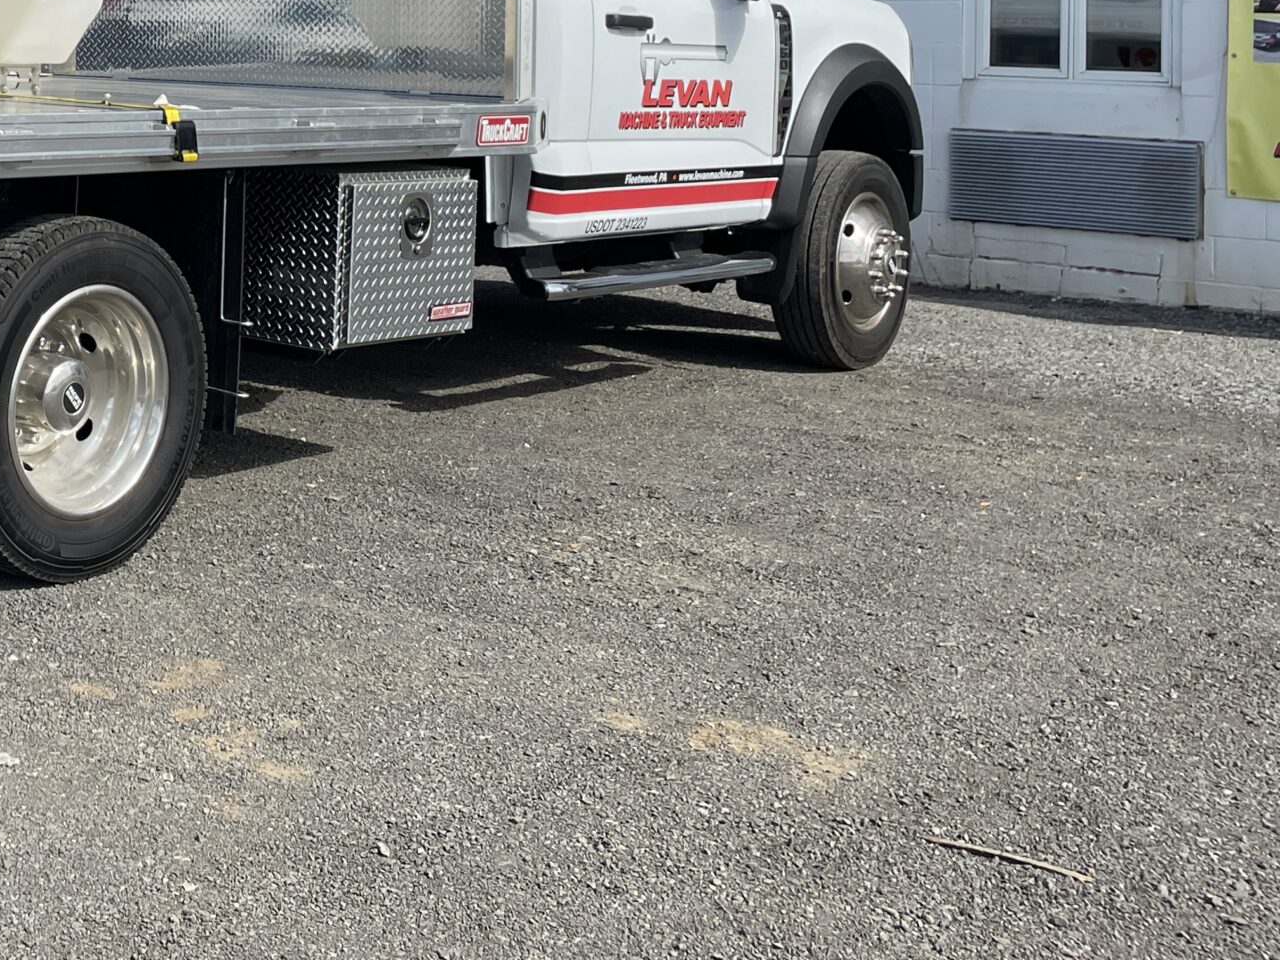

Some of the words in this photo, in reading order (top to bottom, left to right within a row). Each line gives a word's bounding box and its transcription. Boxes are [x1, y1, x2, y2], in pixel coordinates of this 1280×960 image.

[641, 79, 733, 108] LEVAN
[618, 112, 660, 129] MACHINE
[670, 111, 698, 129] TRUCK
[699, 111, 747, 130] EQUIPMENT
[585, 219, 615, 234] USDOT
[615, 217, 648, 231] 2341223
